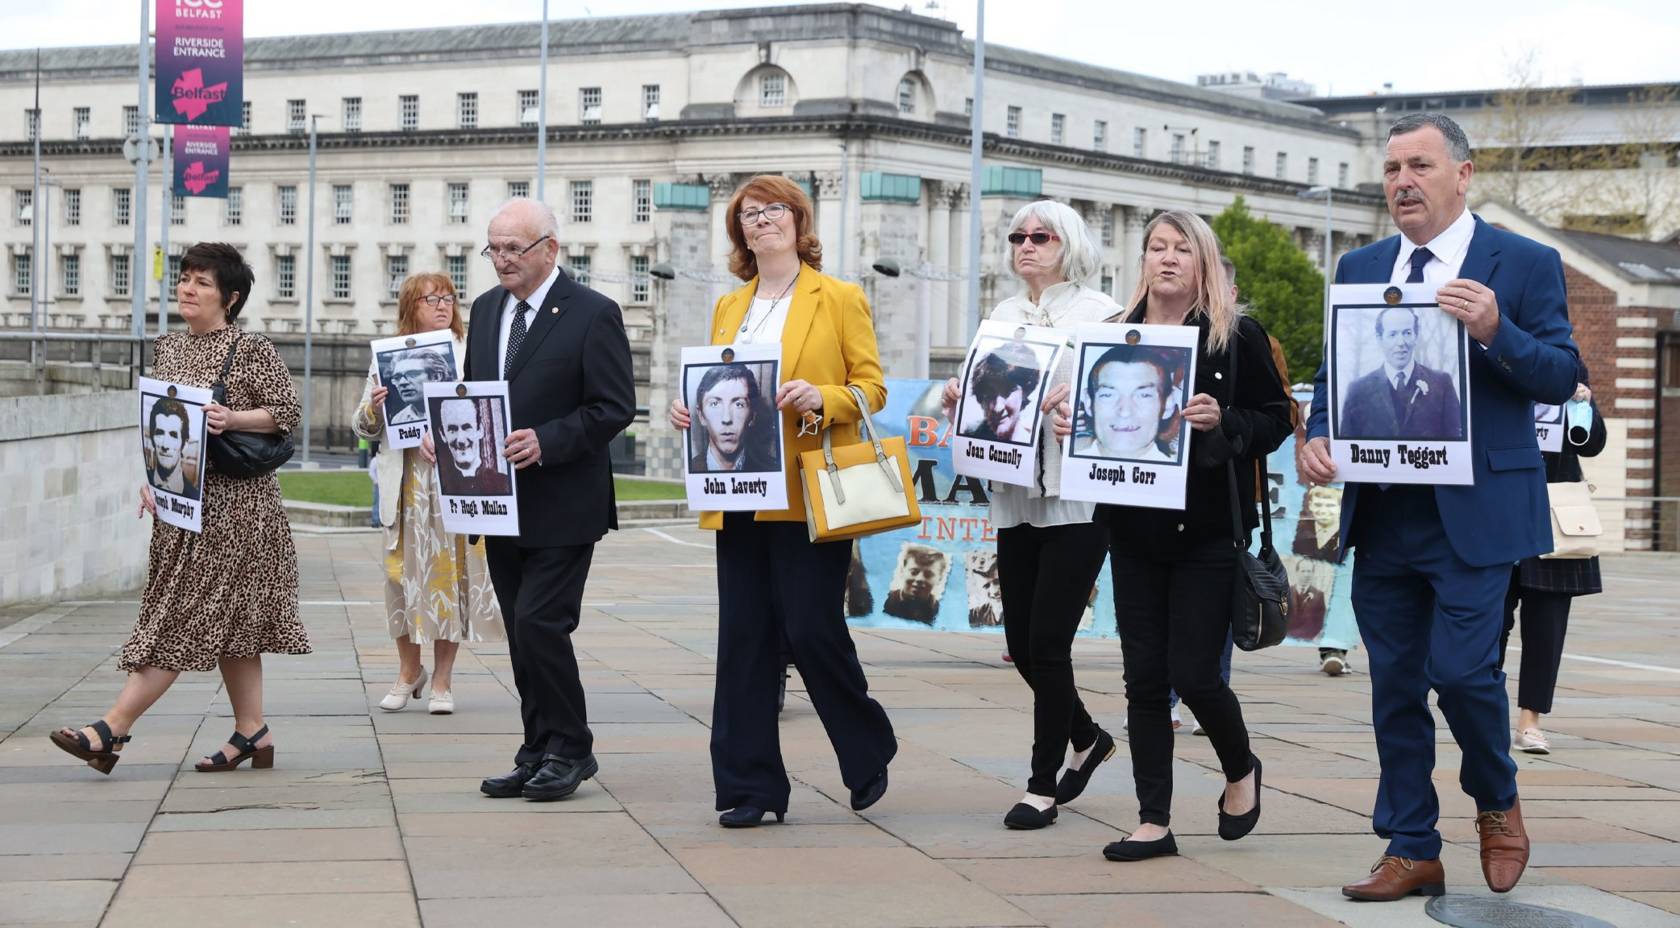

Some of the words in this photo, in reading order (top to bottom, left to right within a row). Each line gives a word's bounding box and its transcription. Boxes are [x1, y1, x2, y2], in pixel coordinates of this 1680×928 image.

[175, 8, 223, 19] BELFAST
[175, 37, 224, 48] RIVERSIDE
[173, 47, 225, 58] ENTRANCE
[174, 86, 225, 100] Belfast
[398, 426, 421, 440] Paddy
[966, 441, 985, 460] Joan
[989, 445, 1022, 470] Connolly
[1350, 443, 1391, 469] Danny
[1397, 444, 1448, 469] Teggart
[1089, 462, 1126, 486] Joseph
[1132, 466, 1156, 485] Corr
[704, 477, 727, 495] John
[730, 477, 767, 498] Laverty
[171, 497, 194, 520] Murphy
[449, 499, 458, 514] Fr
[460, 499, 479, 518] Hugh
[481, 500, 508, 516] Mullan
